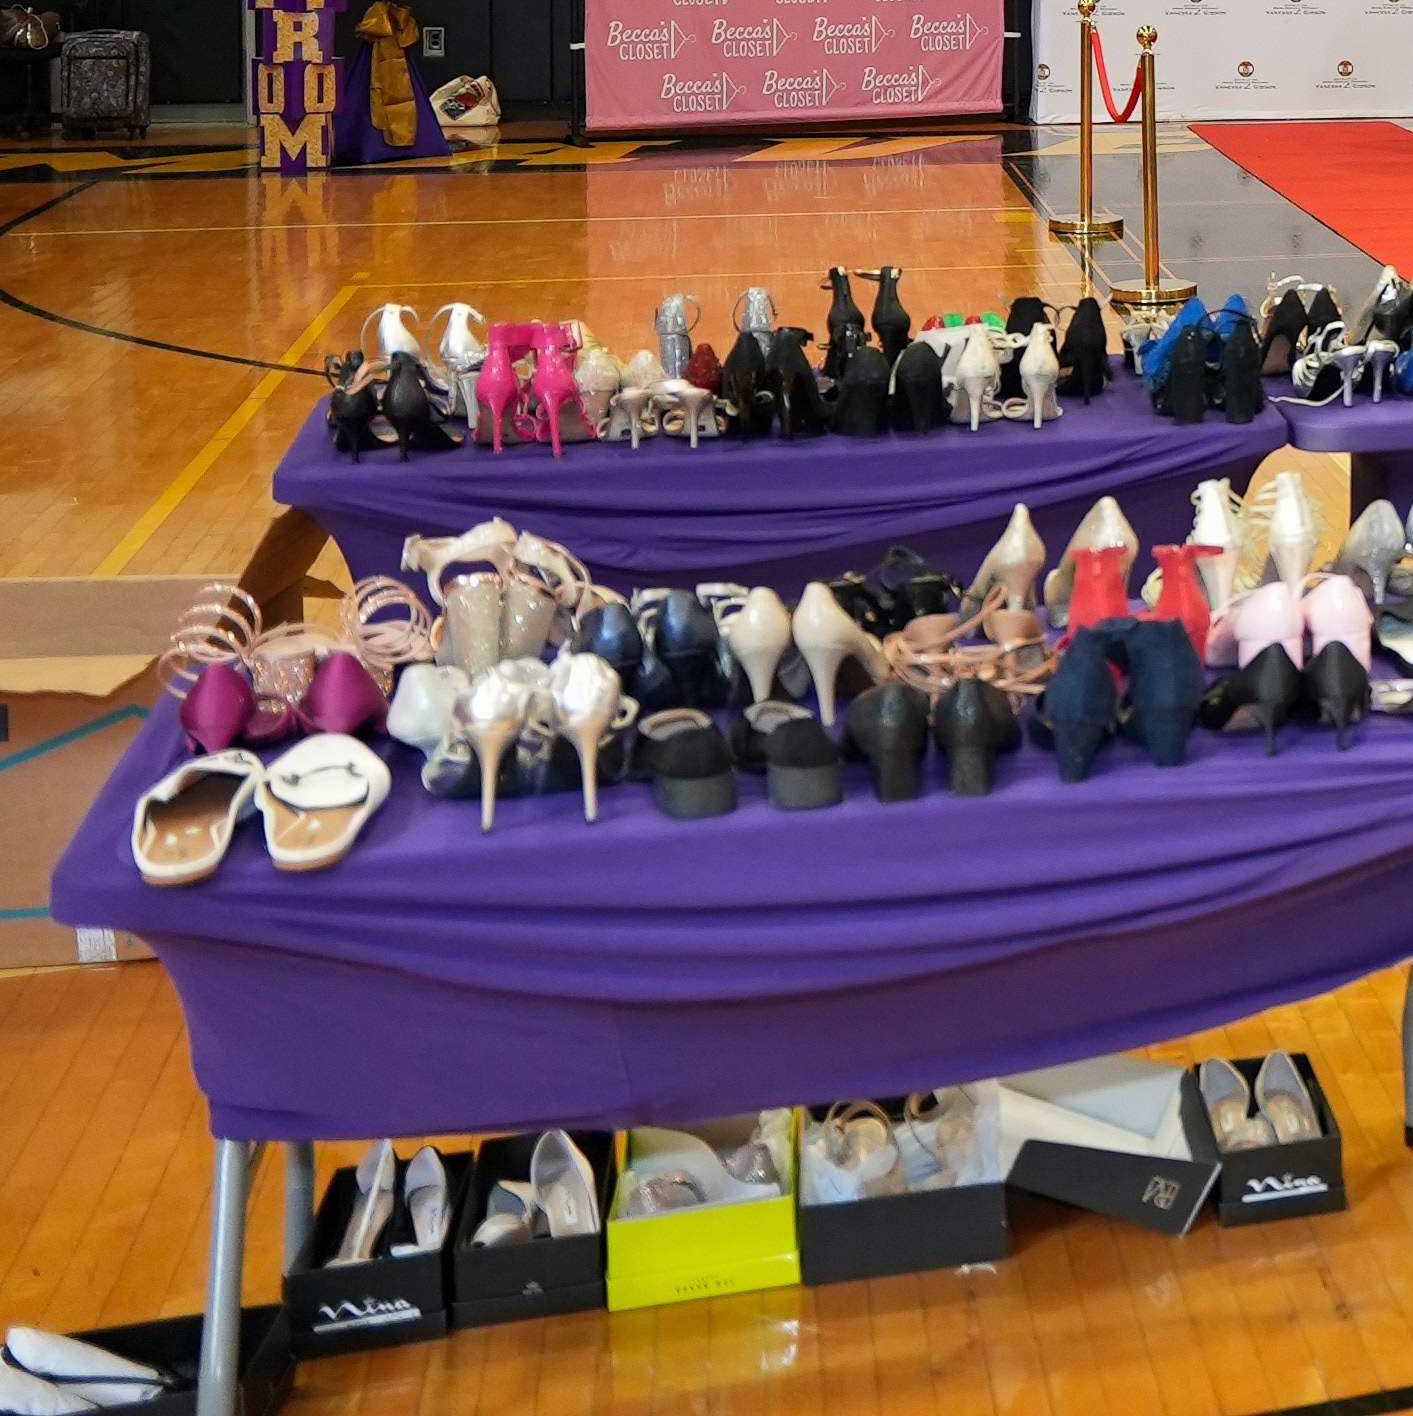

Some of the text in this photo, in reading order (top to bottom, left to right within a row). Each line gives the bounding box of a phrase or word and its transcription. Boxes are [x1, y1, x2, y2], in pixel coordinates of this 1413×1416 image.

[608, 21, 669, 44] Becca's
[911, 14, 964, 36] Becca's
[273, 10, 322, 64] R
[921, 34, 964, 52] CLOSET
[620, 42, 669, 61] CLOSET
[763, 70, 821, 92] Becca's
[774, 90, 821, 108] CLOSET
[260, 113, 328, 167] M
